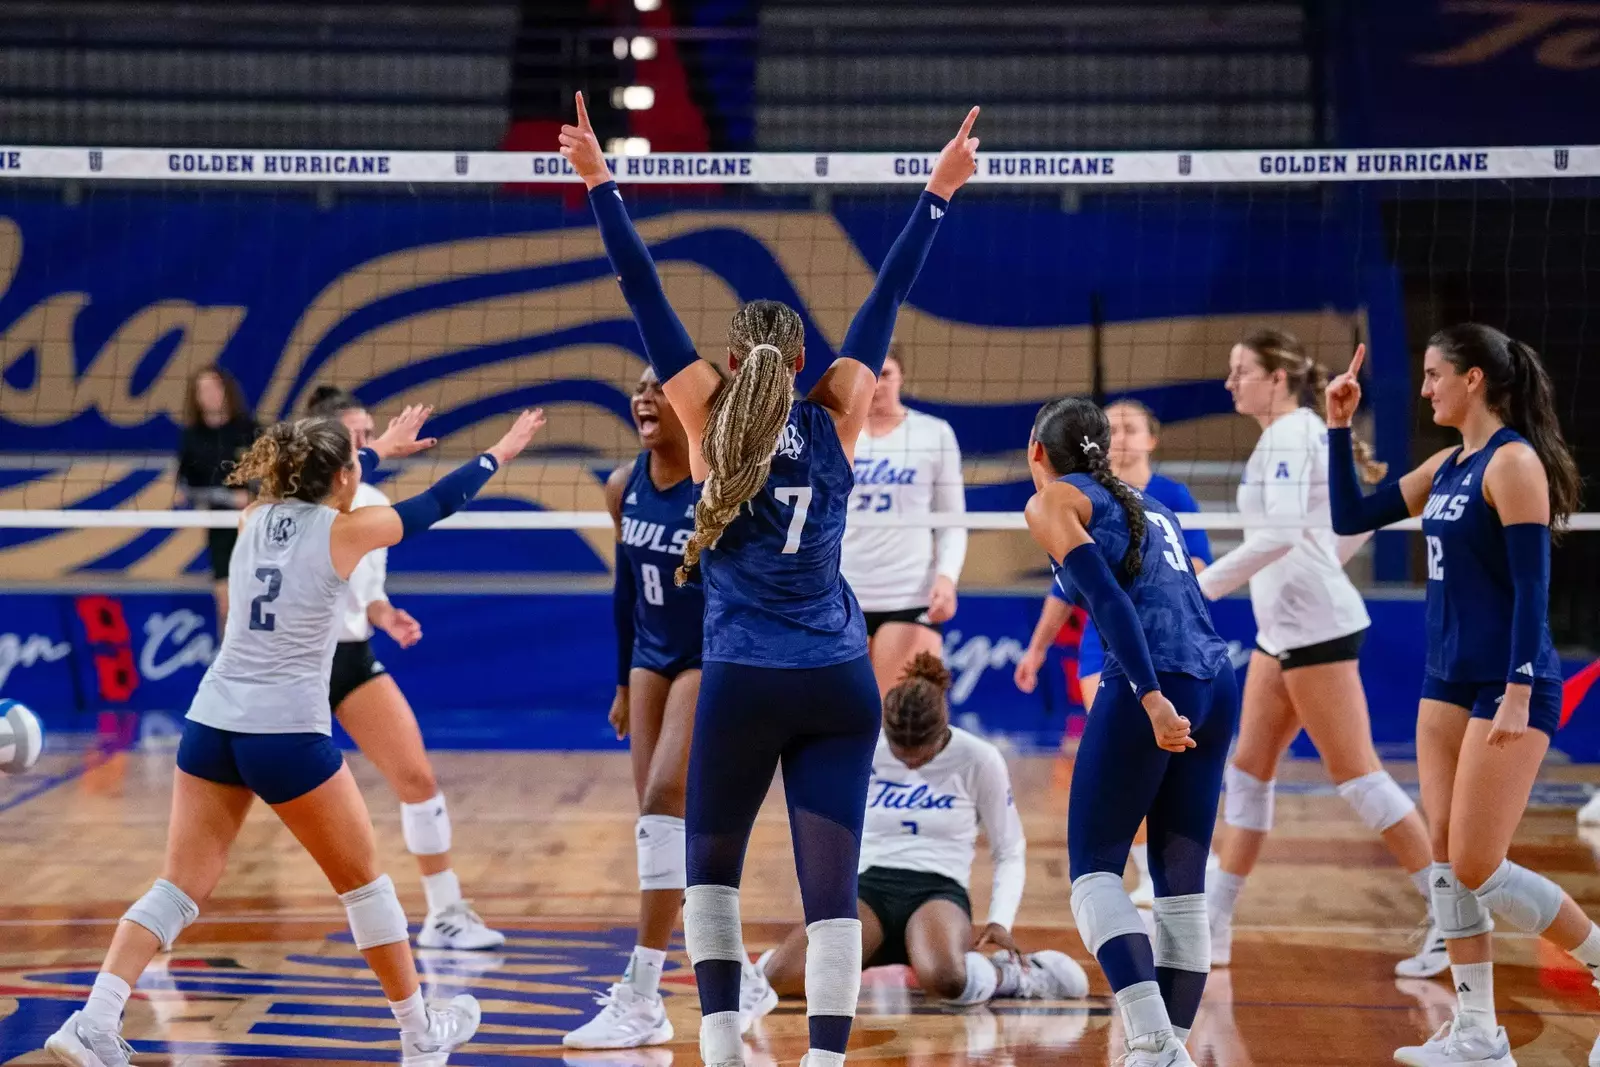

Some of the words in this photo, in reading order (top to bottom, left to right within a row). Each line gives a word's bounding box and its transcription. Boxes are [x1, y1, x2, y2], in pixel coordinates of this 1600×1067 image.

[168, 153, 255, 173] GOLDEN
[264, 155, 390, 174] HURRICANE
[533, 157, 618, 176] GOLN
[627, 157, 752, 176] HURRICANE
[988, 157, 1115, 176] HURRICANE
[1259, 155, 1347, 174] GOLDEN
[1356, 152, 1489, 173] HURRICANE
[774, 486, 812, 554] 7
[1423, 494, 1470, 522] WLS
[1144, 510, 1189, 573] 3
[1426, 534, 1444, 581] 12
[249, 567, 283, 631] 2
[641, 563, 664, 606] 8
[870, 780, 957, 809] Tulsa
